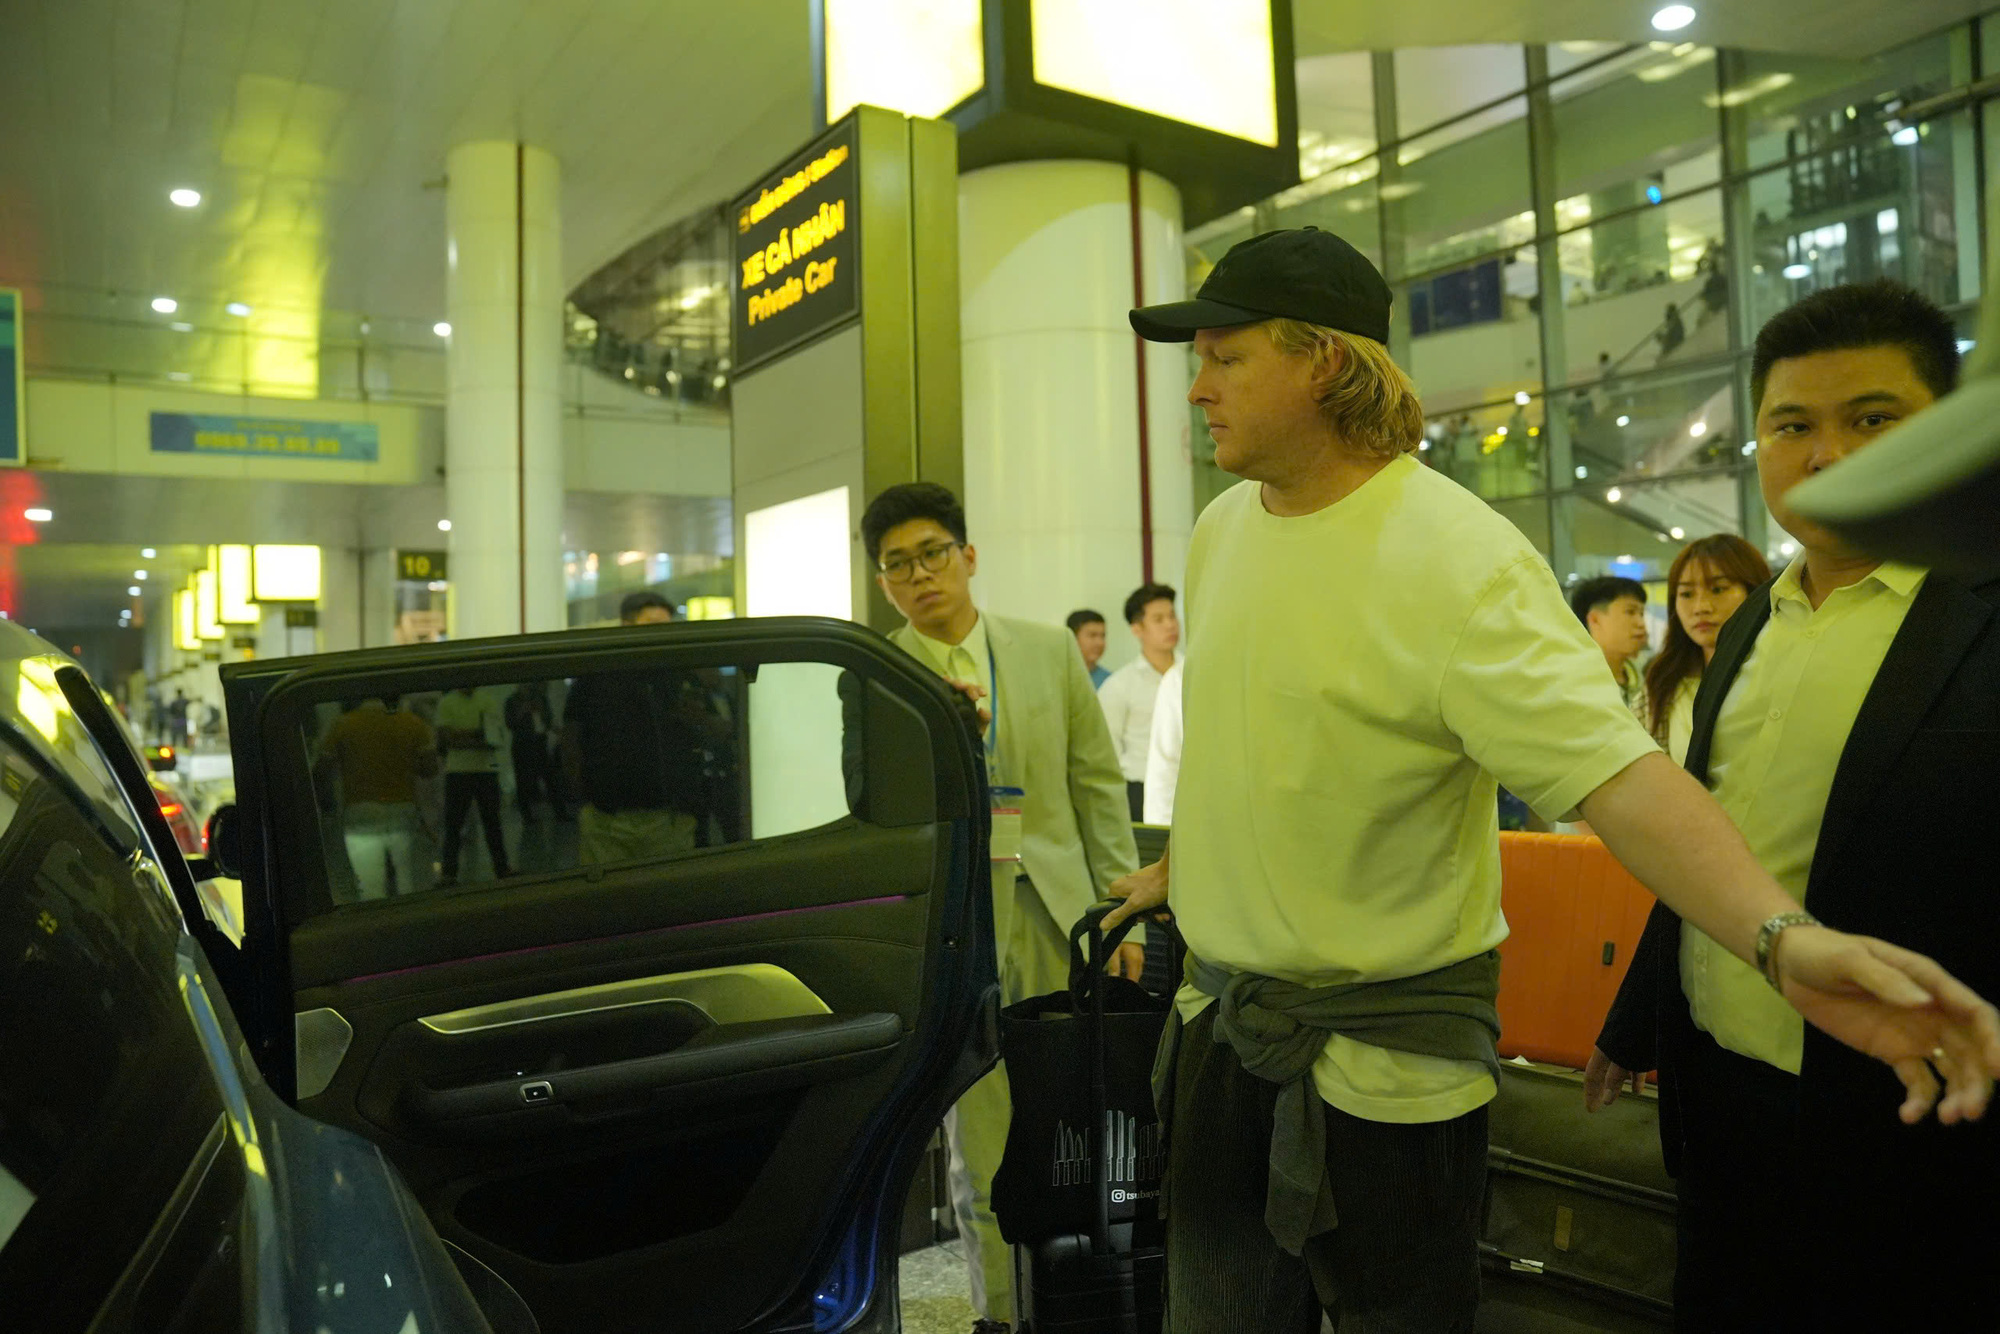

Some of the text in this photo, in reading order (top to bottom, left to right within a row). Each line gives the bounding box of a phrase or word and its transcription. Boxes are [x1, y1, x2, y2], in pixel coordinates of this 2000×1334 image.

[742, 199, 845, 290] XE CÁ NHÂN
[748, 256, 838, 326] Private Car
[404, 555, 431, 577] 10
